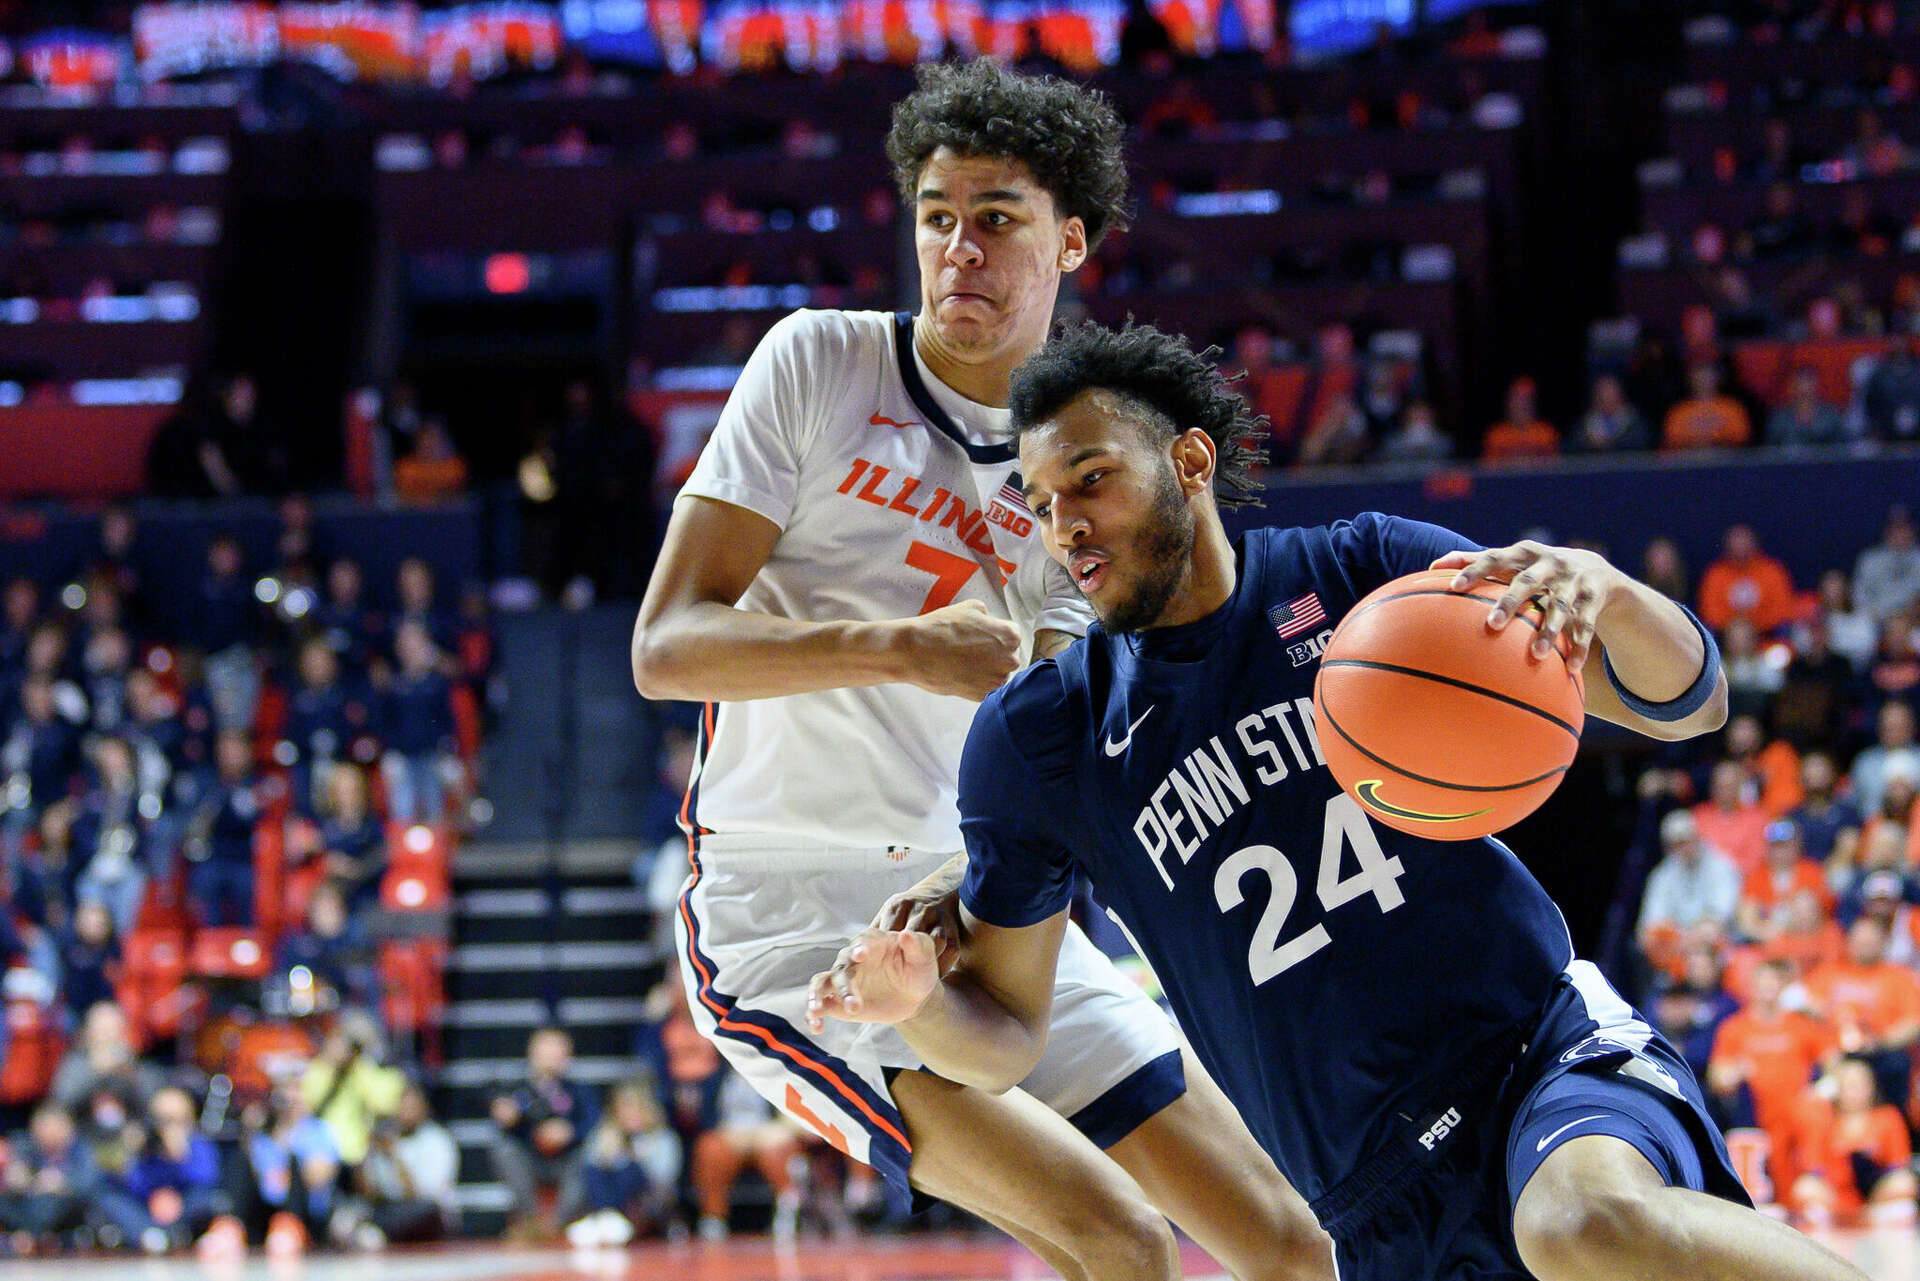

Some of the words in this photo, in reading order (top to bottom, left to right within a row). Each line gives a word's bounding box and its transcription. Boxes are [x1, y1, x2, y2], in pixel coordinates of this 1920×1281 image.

[904, 540, 982, 616] 7
[1133, 736, 1251, 892] PENN
[1213, 792, 1406, 986] 24
[1418, 1106, 1462, 1151] PSU
